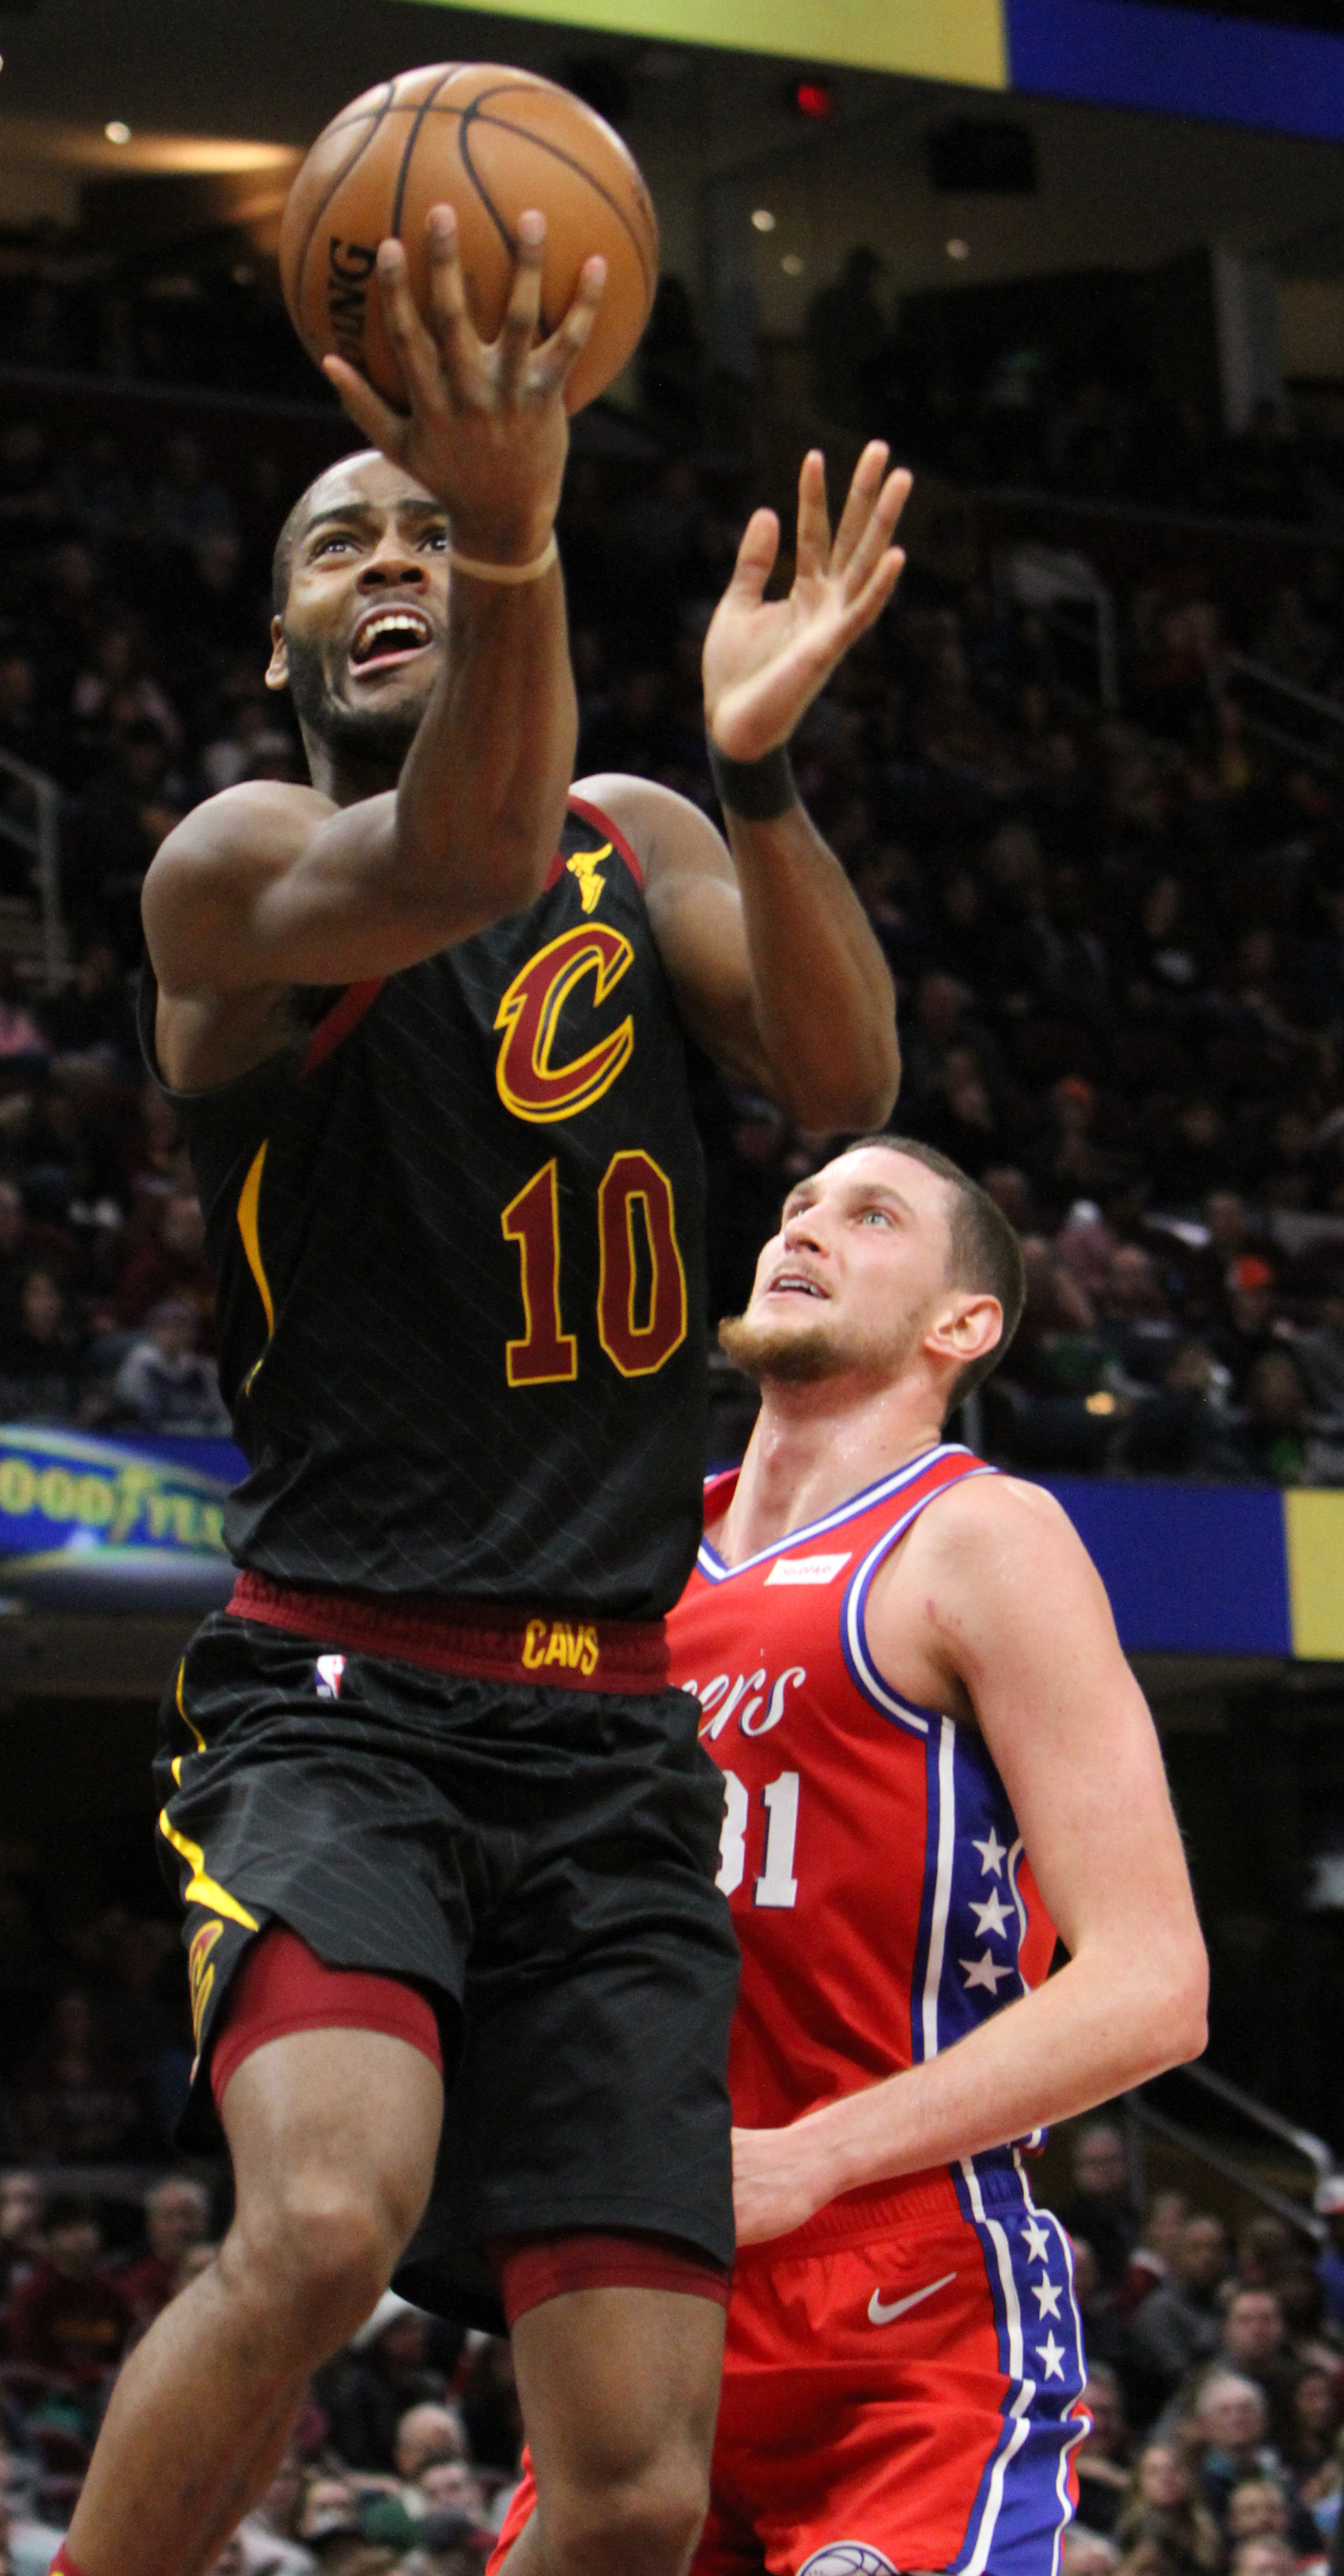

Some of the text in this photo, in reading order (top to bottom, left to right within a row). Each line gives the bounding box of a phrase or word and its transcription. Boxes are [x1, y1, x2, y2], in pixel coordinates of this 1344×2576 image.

[494, 922, 634, 1123] C
[501, 1149, 688, 1388] 10
[522, 1618, 599, 1676] CAVS
